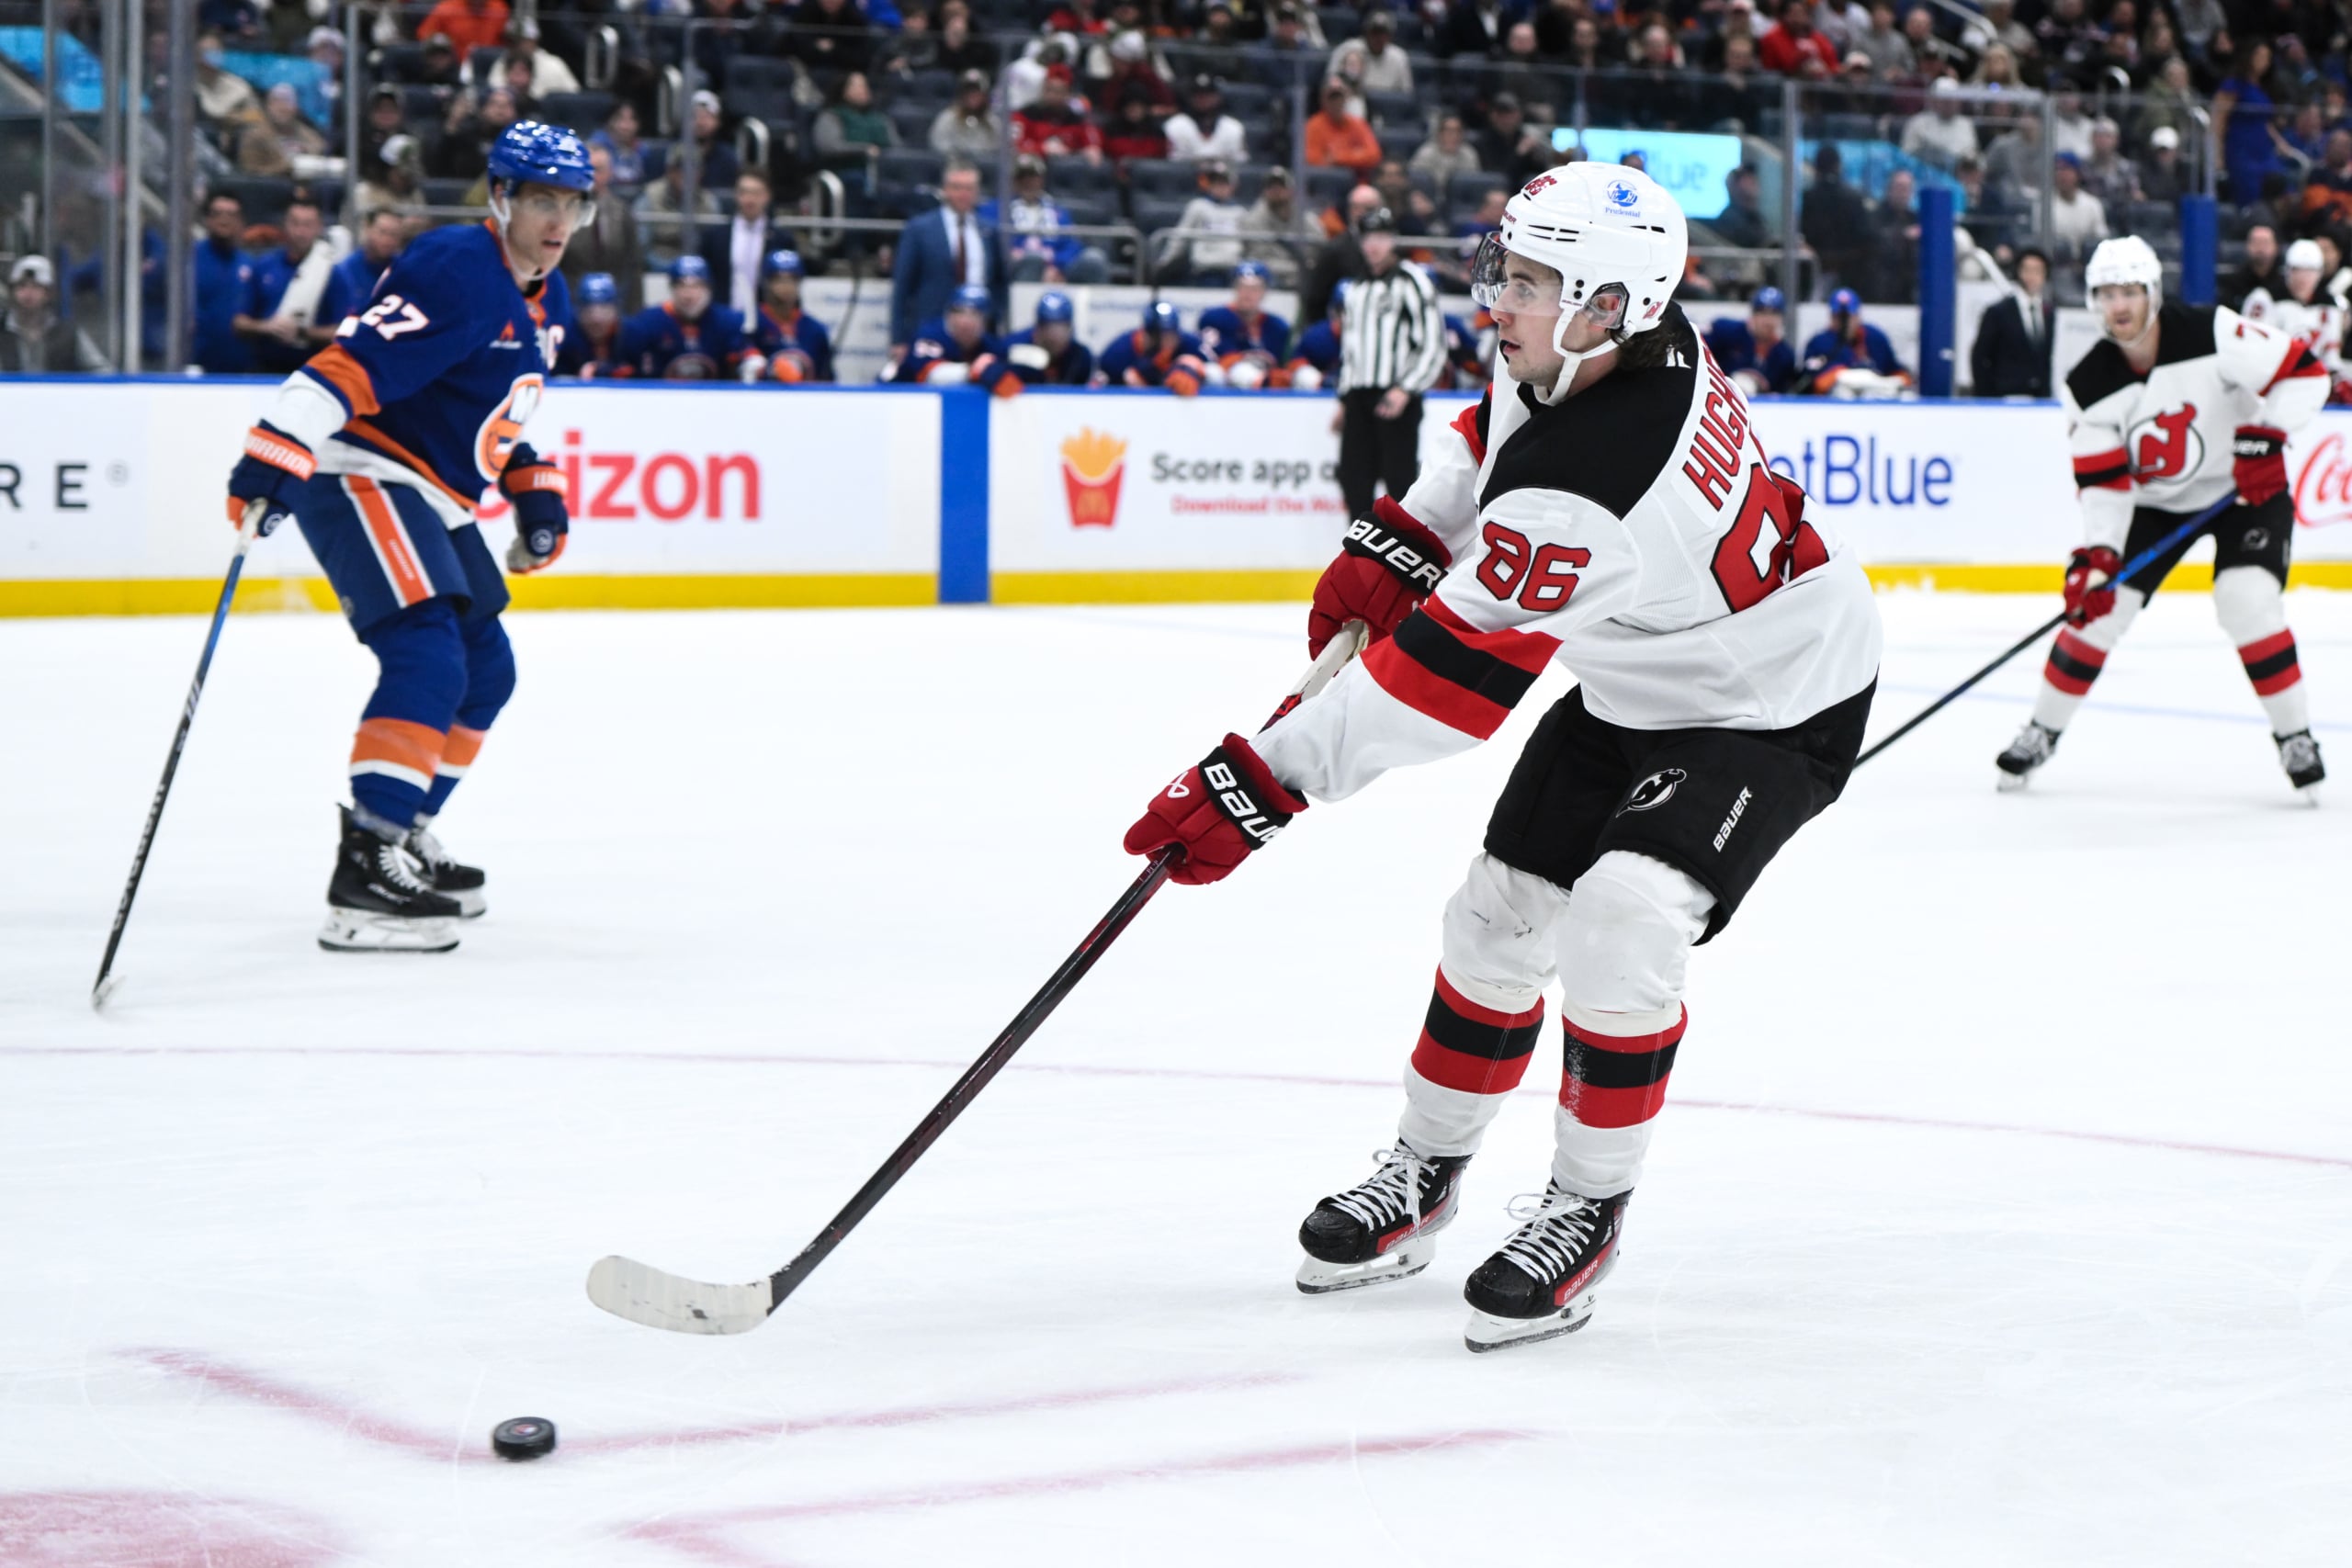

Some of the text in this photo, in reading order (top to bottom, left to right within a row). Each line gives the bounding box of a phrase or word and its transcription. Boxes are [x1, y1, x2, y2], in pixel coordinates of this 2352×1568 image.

[1605, 206, 1641, 219] Prudential
[359, 293, 430, 341] 27
[1151, 453, 1243, 482] Score
[1252, 460, 1311, 491] app
[1476, 521, 1591, 612] 86
[1713, 785, 1753, 852] BAUER
[1564, 1259, 1599, 1301] BAUER
